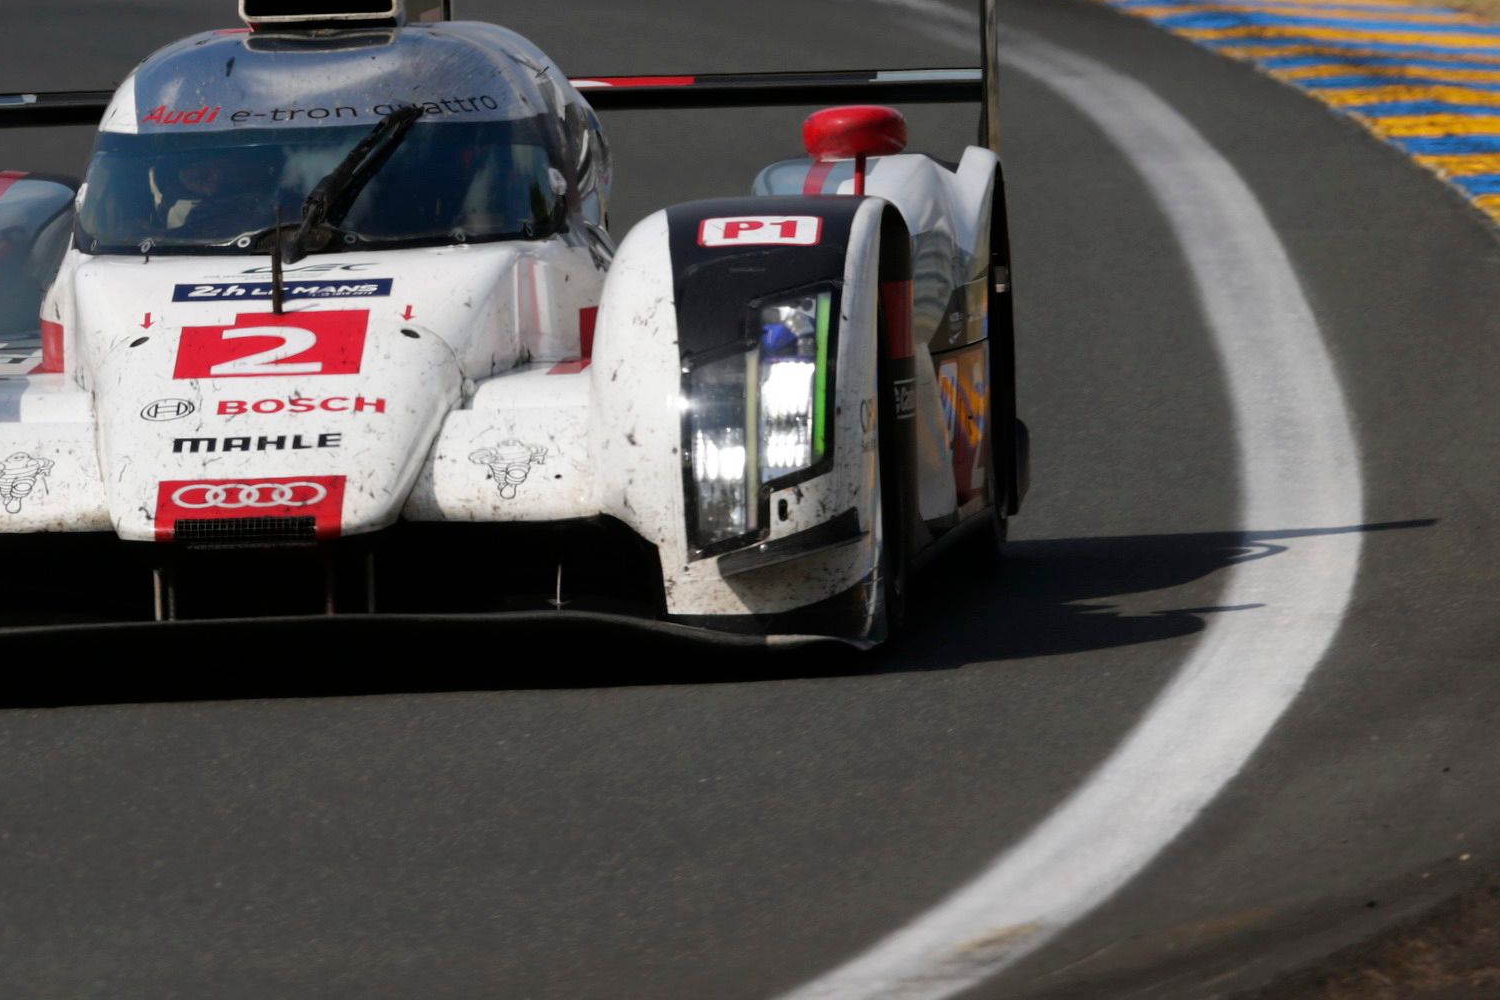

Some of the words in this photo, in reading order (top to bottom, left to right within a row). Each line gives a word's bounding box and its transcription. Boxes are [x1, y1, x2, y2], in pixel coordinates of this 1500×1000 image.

[141, 103, 222, 125] Audi
[230, 103, 357, 123] e-tron
[723, 220, 798, 239] P1
[210, 326, 323, 376] 2
[216, 396, 386, 416] BOSCH
[172, 433, 343, 454] MAHLE
